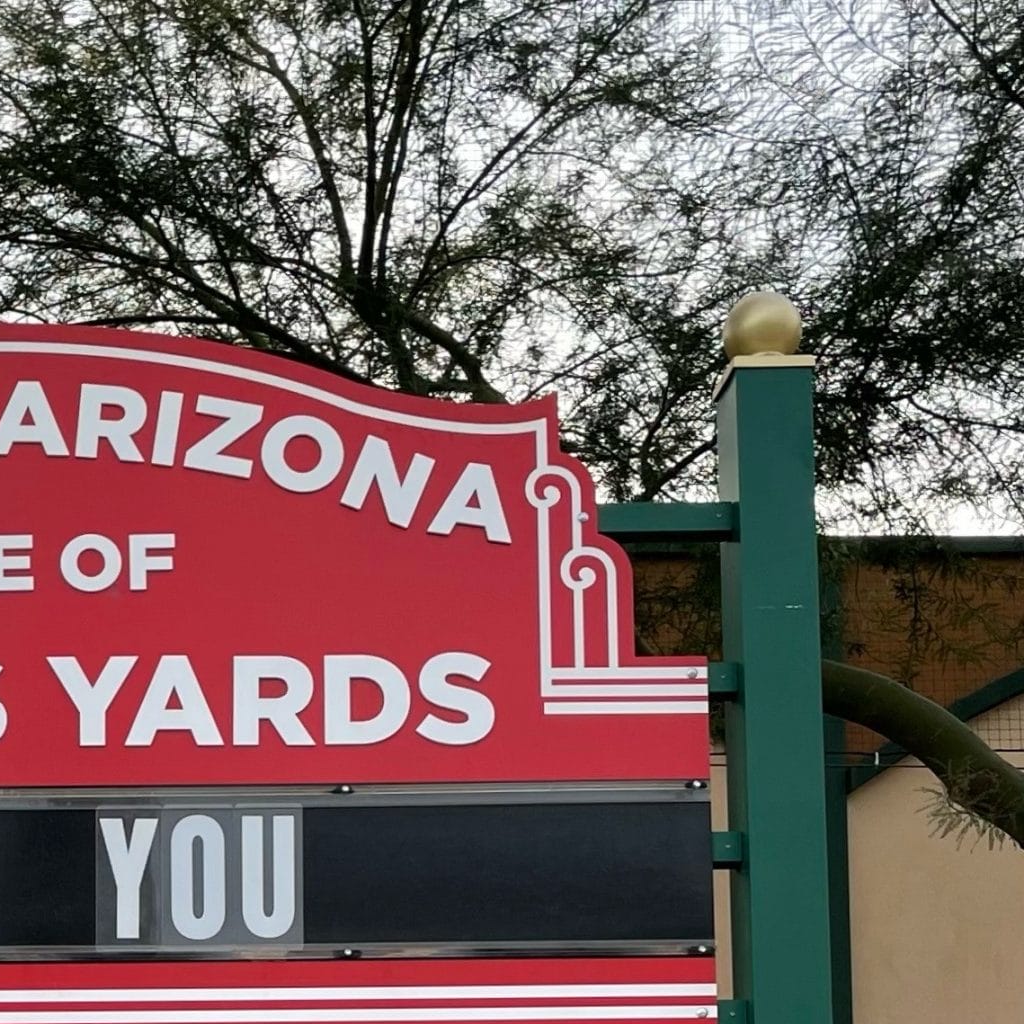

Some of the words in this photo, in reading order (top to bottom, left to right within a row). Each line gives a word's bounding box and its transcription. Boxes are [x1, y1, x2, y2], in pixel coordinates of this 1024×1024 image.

[60, 533, 175, 592] OF
[47, 651, 496, 747] YARDS
[99, 814, 295, 941] YOU
